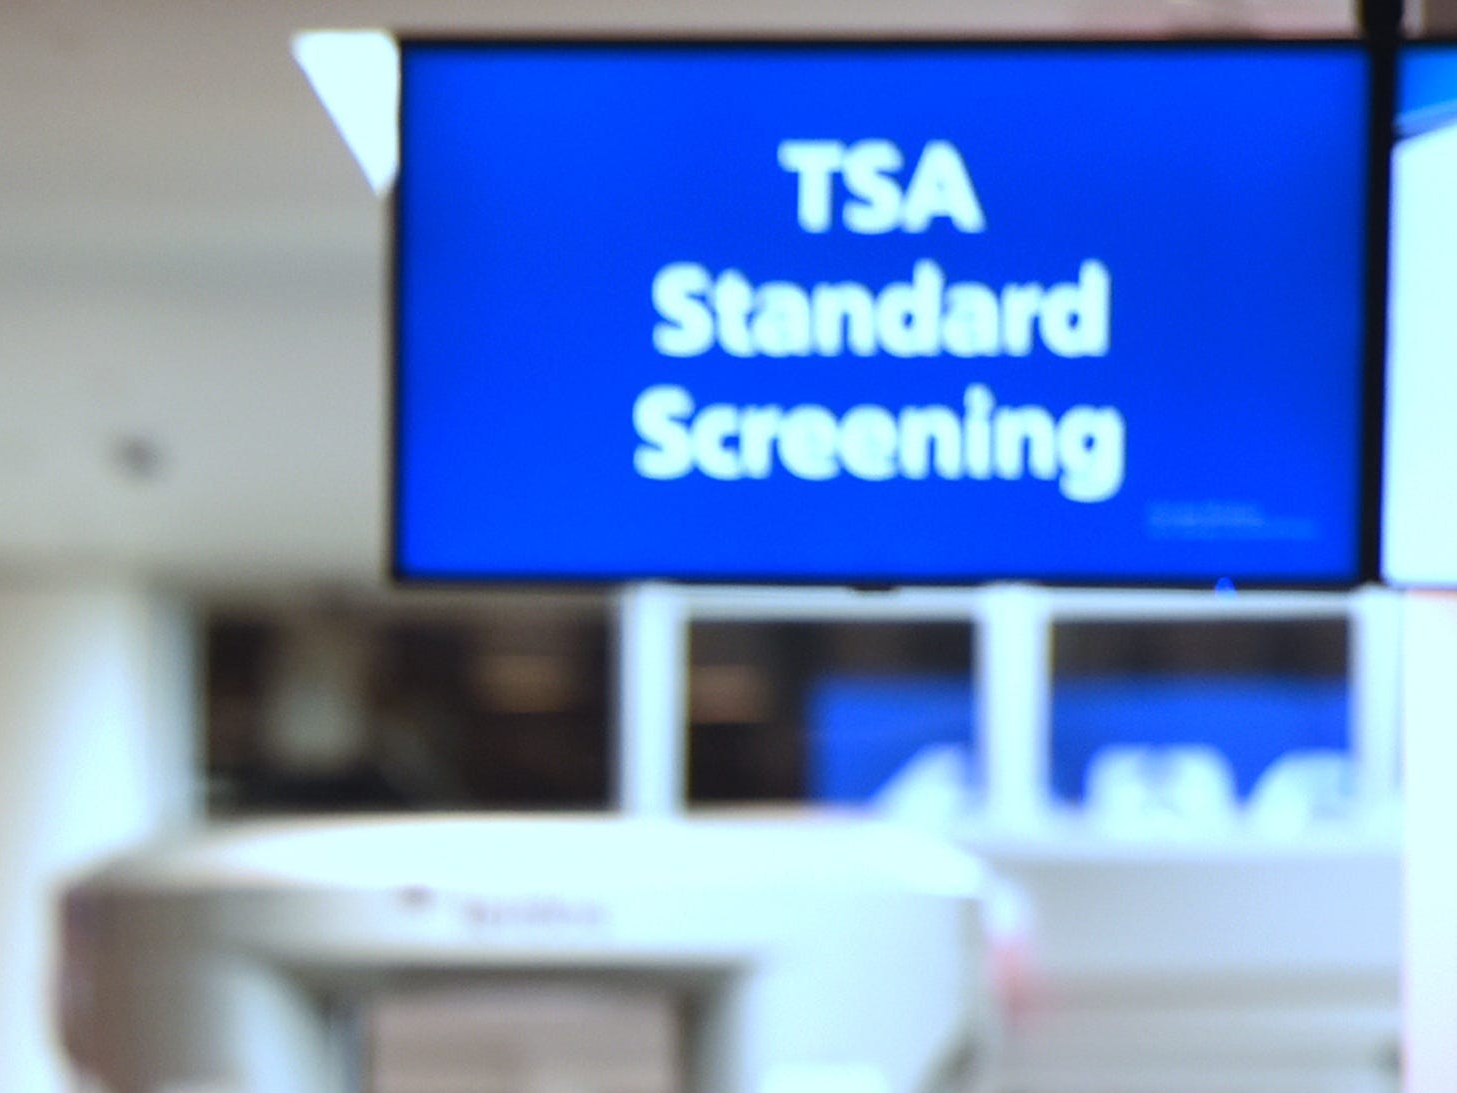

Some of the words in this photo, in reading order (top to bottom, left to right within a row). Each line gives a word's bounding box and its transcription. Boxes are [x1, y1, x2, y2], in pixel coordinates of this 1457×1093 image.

[778, 141, 985, 233] TSA
[653, 260, 1110, 357] Standard
[634, 384, 1125, 502] Screening
